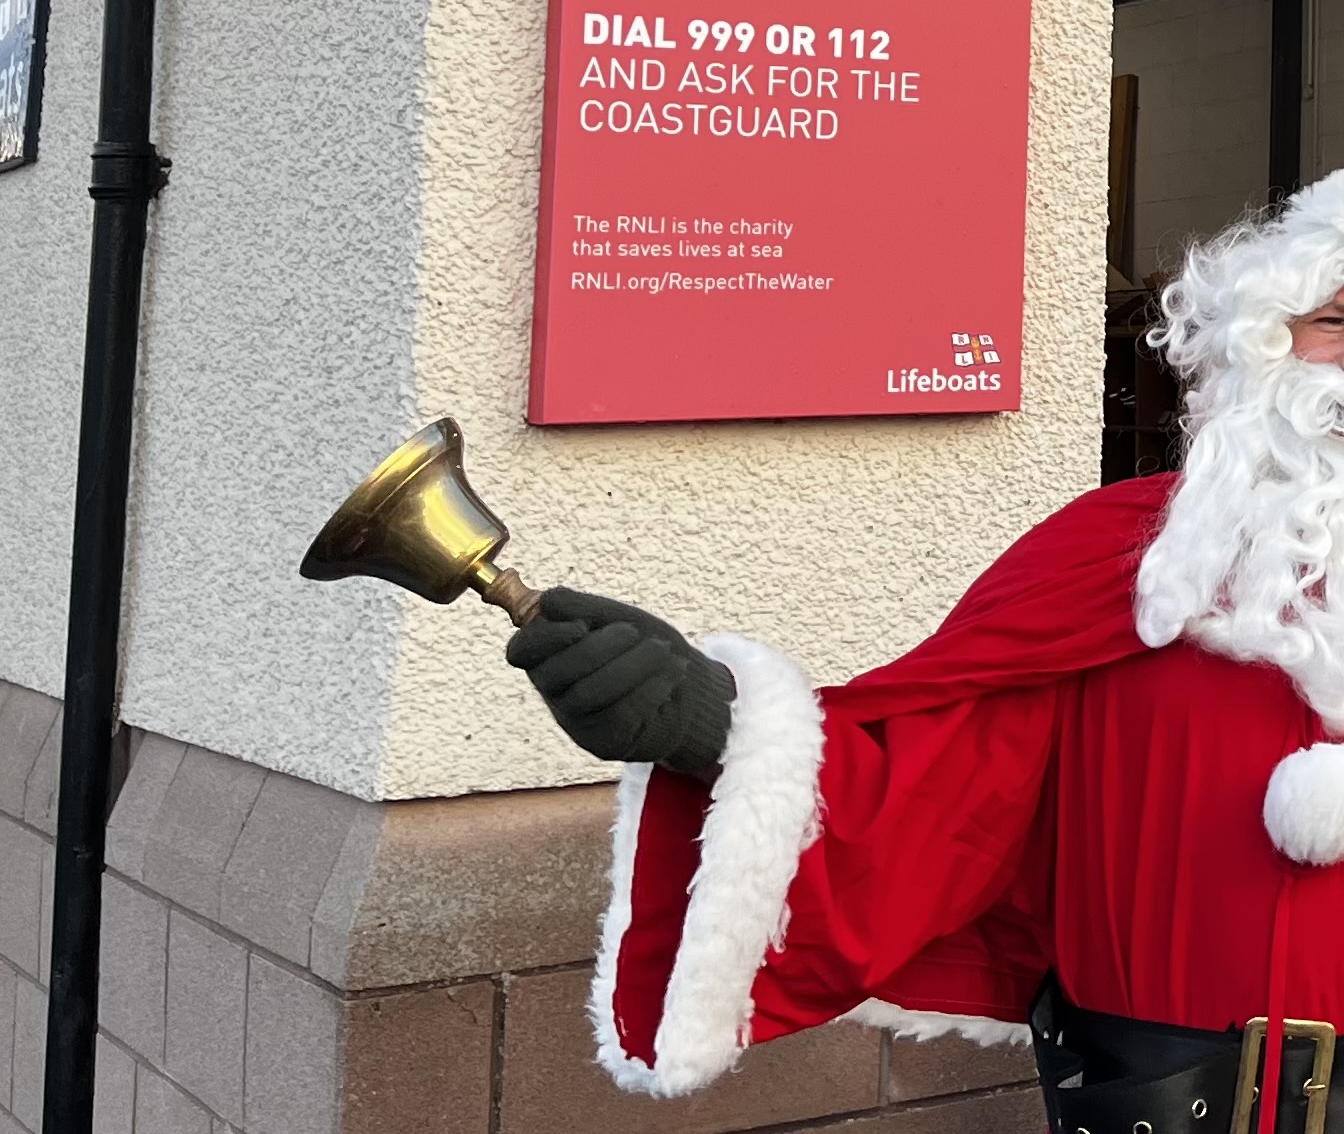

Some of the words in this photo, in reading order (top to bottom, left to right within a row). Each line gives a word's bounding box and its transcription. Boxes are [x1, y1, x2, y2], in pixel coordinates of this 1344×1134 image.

[583, 12, 677, 49] DIAL
[687, 19, 755, 53] 999
[765, 24, 816, 57] OR
[828, 27, 890, 61] 112
[579, 56, 666, 91] AND
[677, 61, 755, 95] ASK
[768, 65, 839, 99] FOR
[850, 69, 920, 103] THE
[580, 99, 838, 140] COASTGUARD
[573, 215, 610, 233] The
[617, 215, 665, 234] RNLI
[672, 216, 688, 235] is
[694, 217, 724, 235] the
[729, 218, 793, 240] charity
[572, 239, 611, 256] that
[618, 243, 673, 257] saves
[679, 240, 722, 257] lives
[727, 241, 745, 257] at
[751, 245, 783, 258] sea
[571, 271, 834, 296] RNLI.org/RespectTheWater
[887, 367, 1002, 393] Lifeboats
